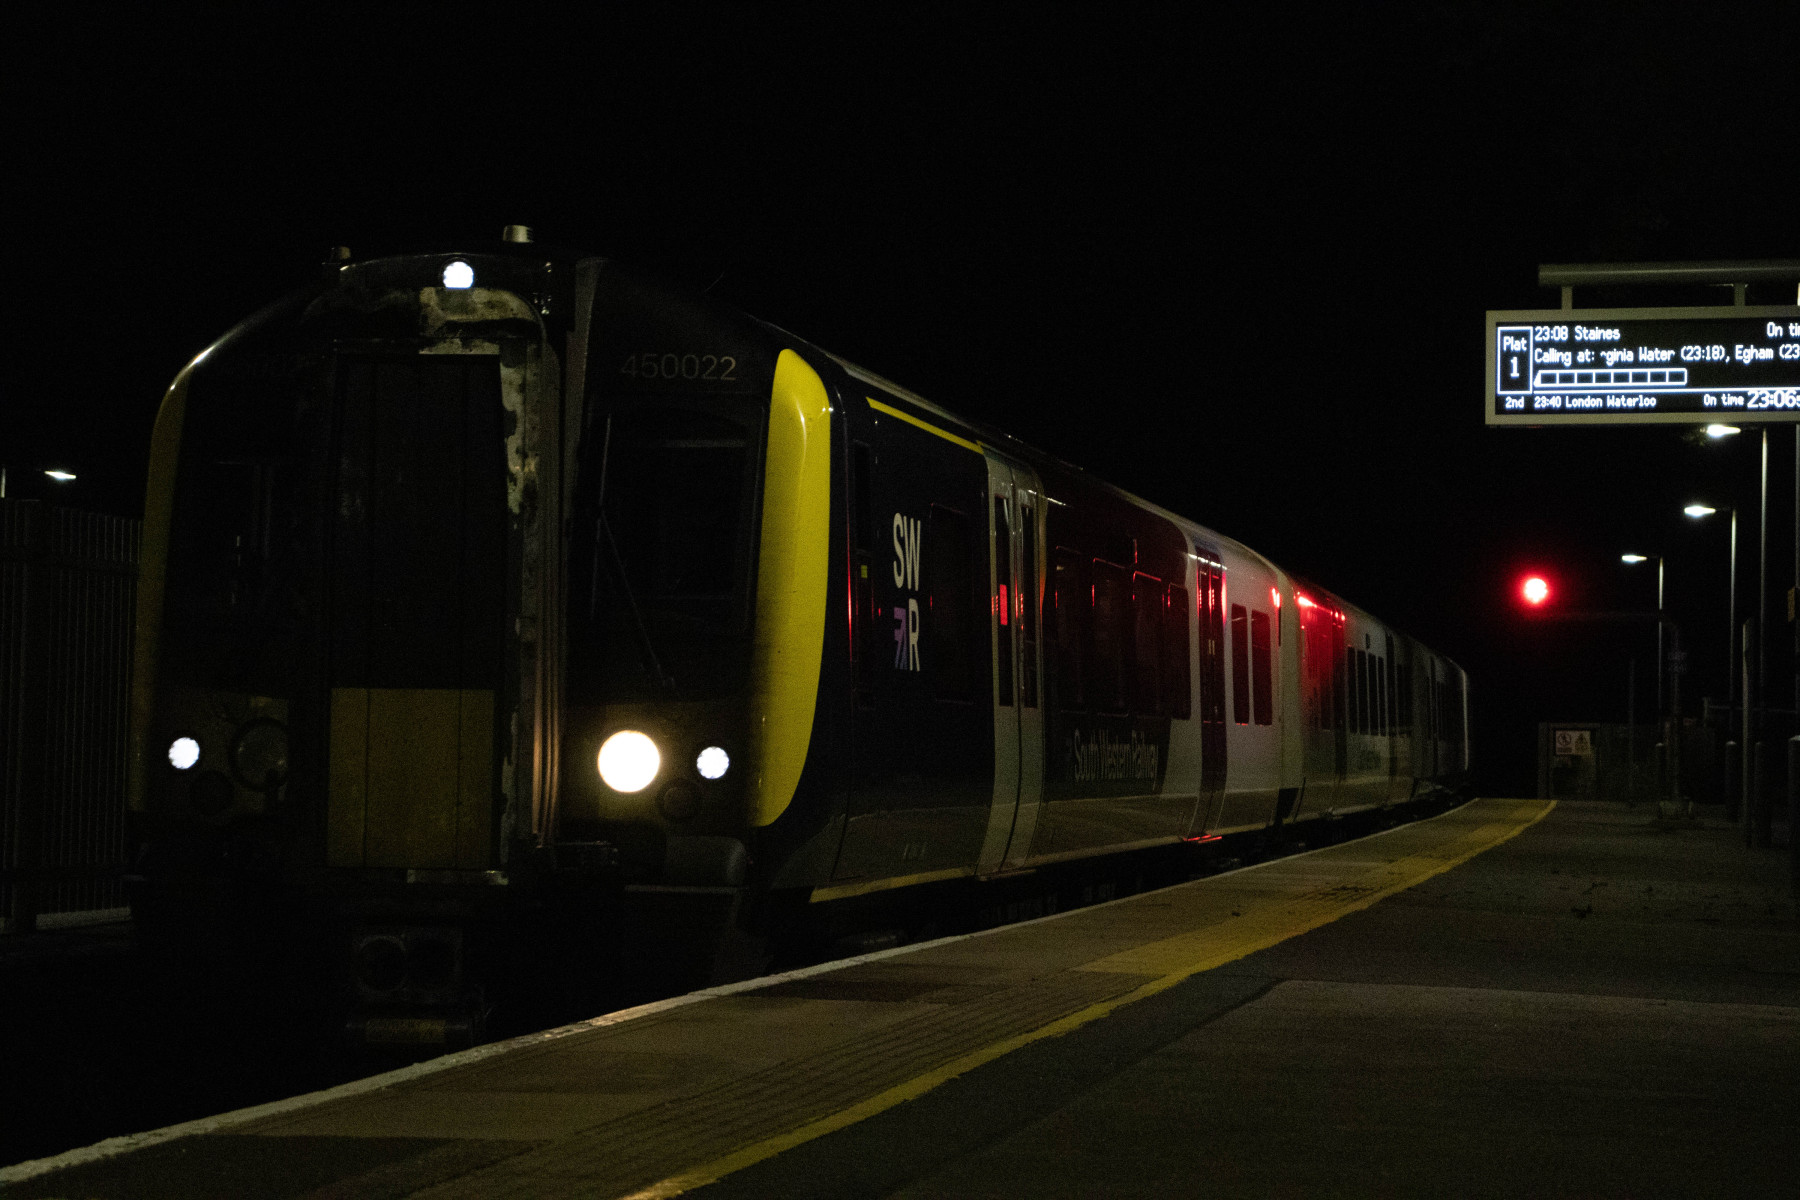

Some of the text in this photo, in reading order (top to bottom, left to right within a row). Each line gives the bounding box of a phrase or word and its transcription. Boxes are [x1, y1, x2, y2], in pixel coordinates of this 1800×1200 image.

[1534, 325, 1621, 341] 23:08 Staines
[1766, 321, 1783, 337] On
[1503, 335, 1527, 352] Plat
[1534, 347, 1572, 367] Calling
[1576, 348, 1595, 363] at:
[1638, 346, 1676, 362] Water
[1735, 343, 1774, 365] Egham
[621, 352, 737, 381] 450022
[1510, 356, 1520, 378] 1
[1505, 394, 1657, 409] 2nd 23:40 London Waterloo
[1703, 393, 1745, 407] On time
[893, 512, 921, 592] SW
